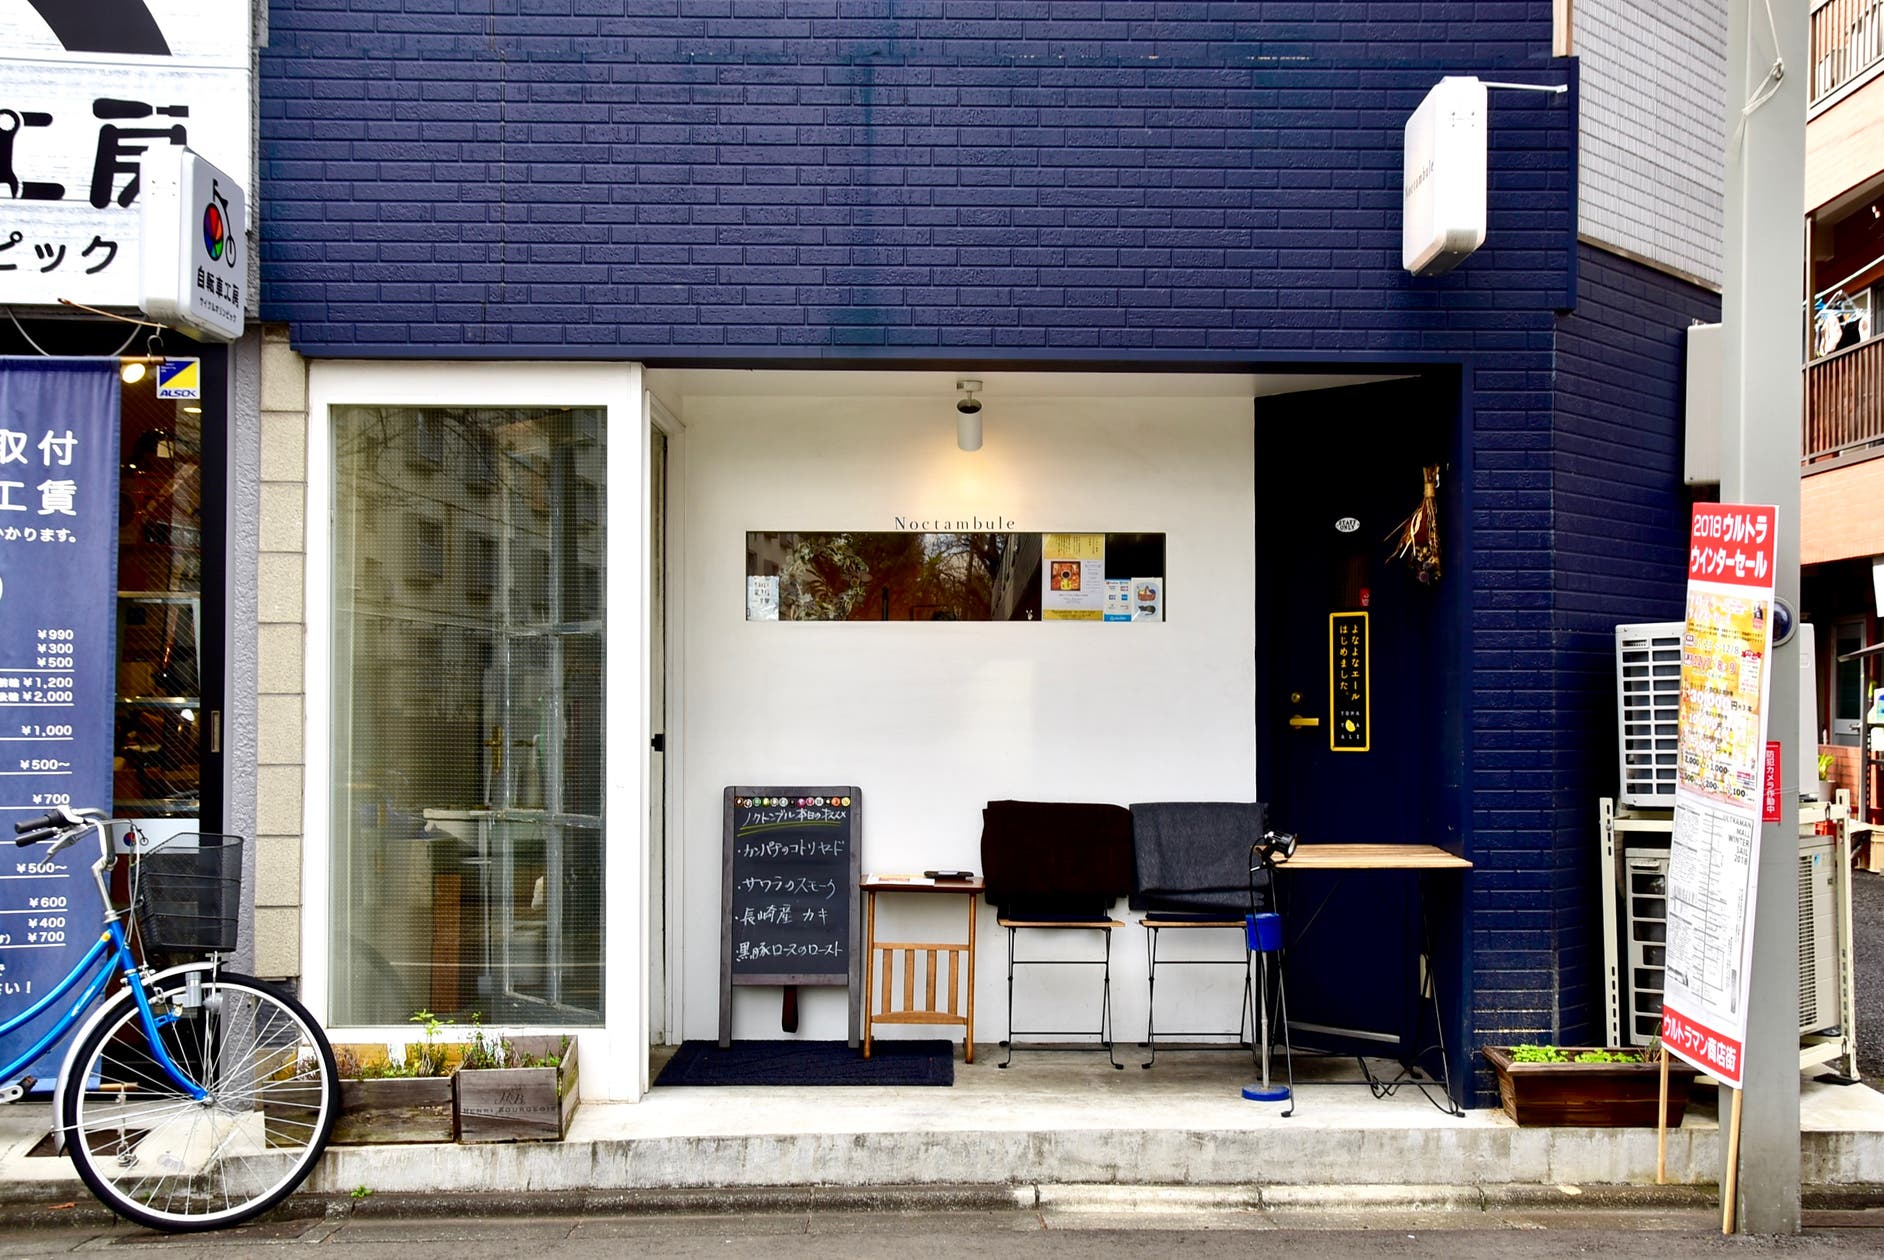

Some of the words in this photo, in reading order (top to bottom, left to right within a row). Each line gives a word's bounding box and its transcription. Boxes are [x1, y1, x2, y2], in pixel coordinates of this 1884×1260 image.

[197, 265, 240, 309] 自転車工房
[160, 389, 197, 398] ALSOK
[895, 516, 1015, 530] Noctambule
[1693, 513, 1768, 543] 2018ウルトラ
[0, 527, 77, 543] かります。
[1691, 545, 1768, 578] ウインターセール
[38, 629, 74, 640] ¥990
[37, 643, 74, 654] ¥300
[37, 657, 73, 668] ¥500
[1351, 624, 1361, 701] よなよなエール
[23, 677, 73, 689] ¥1,200
[22, 691, 73, 703] ¥2,000
[21, 725, 72, 737] ¥1,000
[1766, 750, 1776, 813] 防犯カメラ作動中
[32, 794, 70, 804] ¥700
[29, 897, 67, 908] ¥600
[28, 917, 66, 928] ¥400
[27, 931, 65, 943] ¥700
[1664, 1013, 1737, 1072] ウルトラマン商店街
